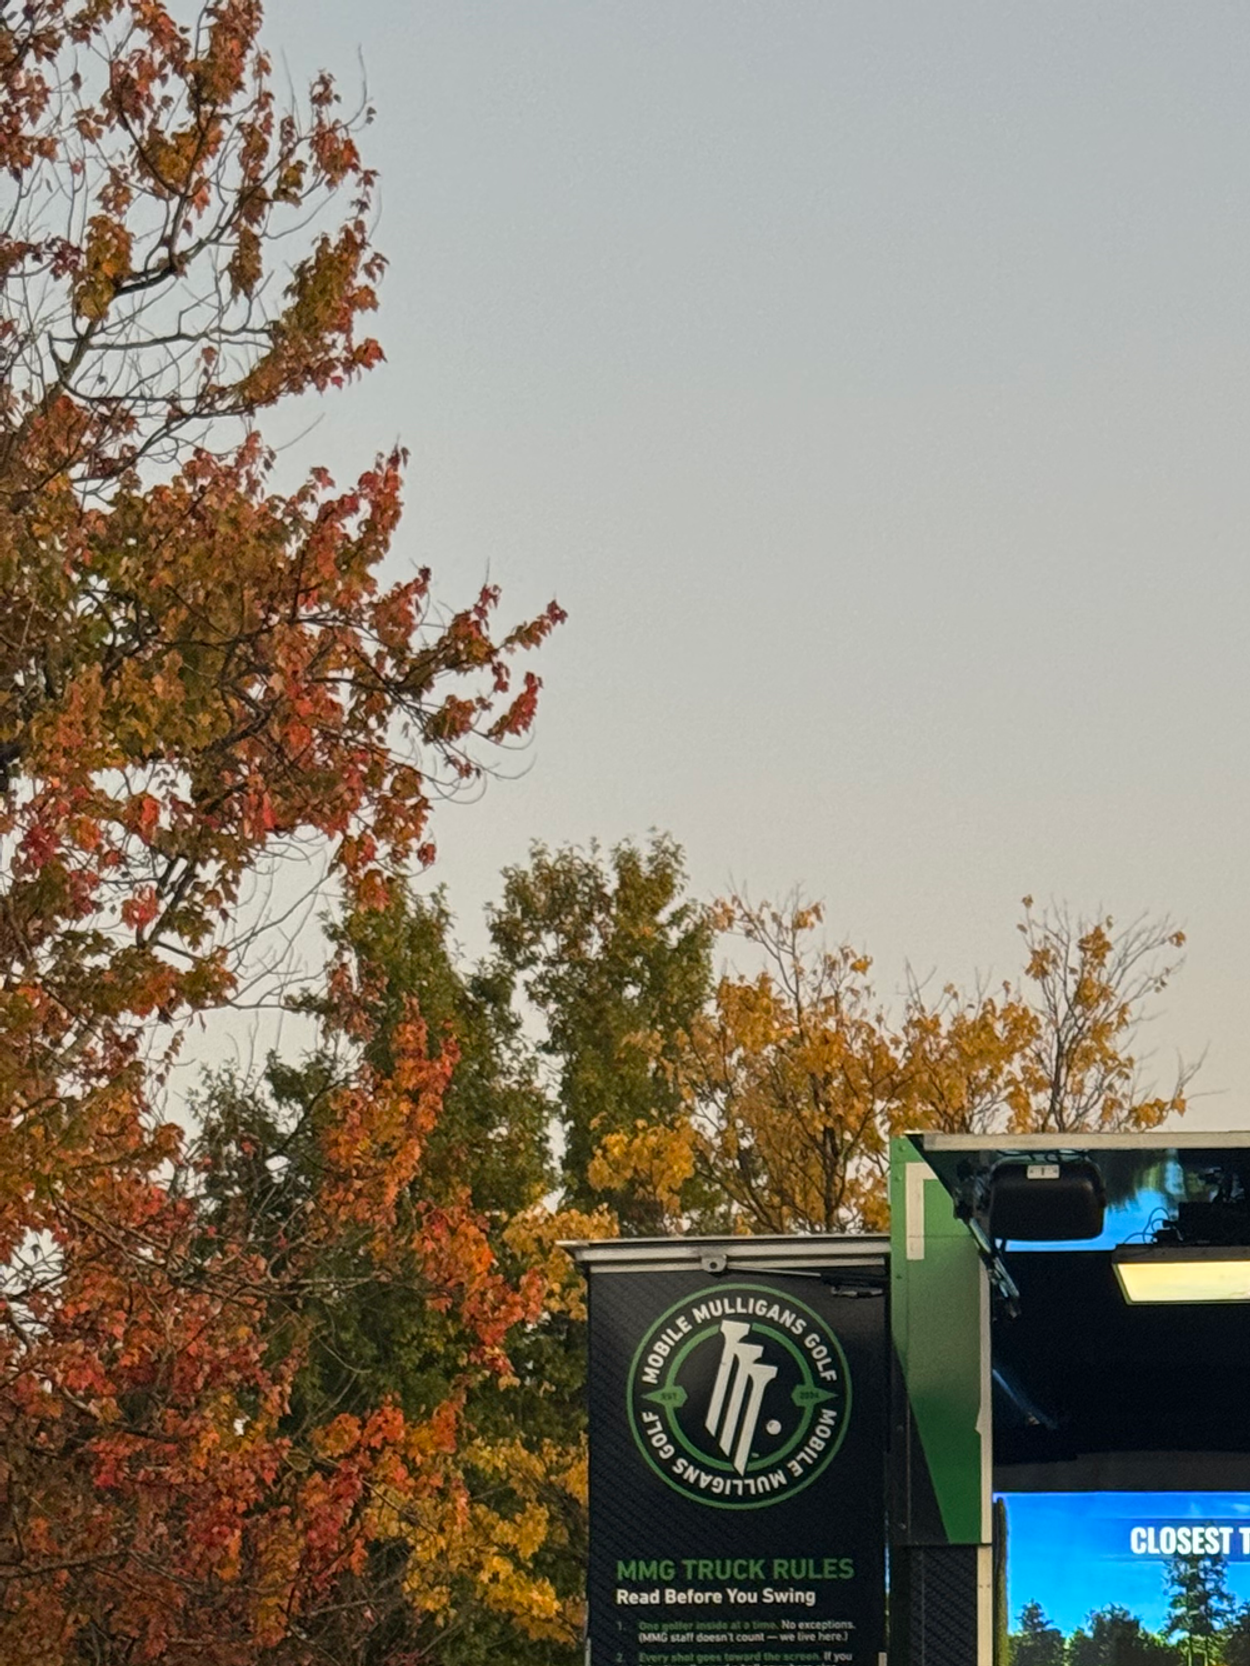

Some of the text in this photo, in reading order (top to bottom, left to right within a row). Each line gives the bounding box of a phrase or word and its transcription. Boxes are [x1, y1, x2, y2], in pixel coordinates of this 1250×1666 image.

[642, 1297, 837, 1384] MOBILE MULLIGANS GOLF
[642, 1409, 837, 1495] MOBILE MULLIGANS GOLF
[1130, 1526, 1234, 1554] CLOSEST
[617, 1559, 853, 1580] MMG TRUCK RULES
[615, 1589, 816, 1605] Read Before You Swing
[781, 1620, 856, 1631] No exceptions.
[638, 1631, 848, 1645] (MMG staff doesn't count we live here.)
[823, 1652, 853, 1663] If you
